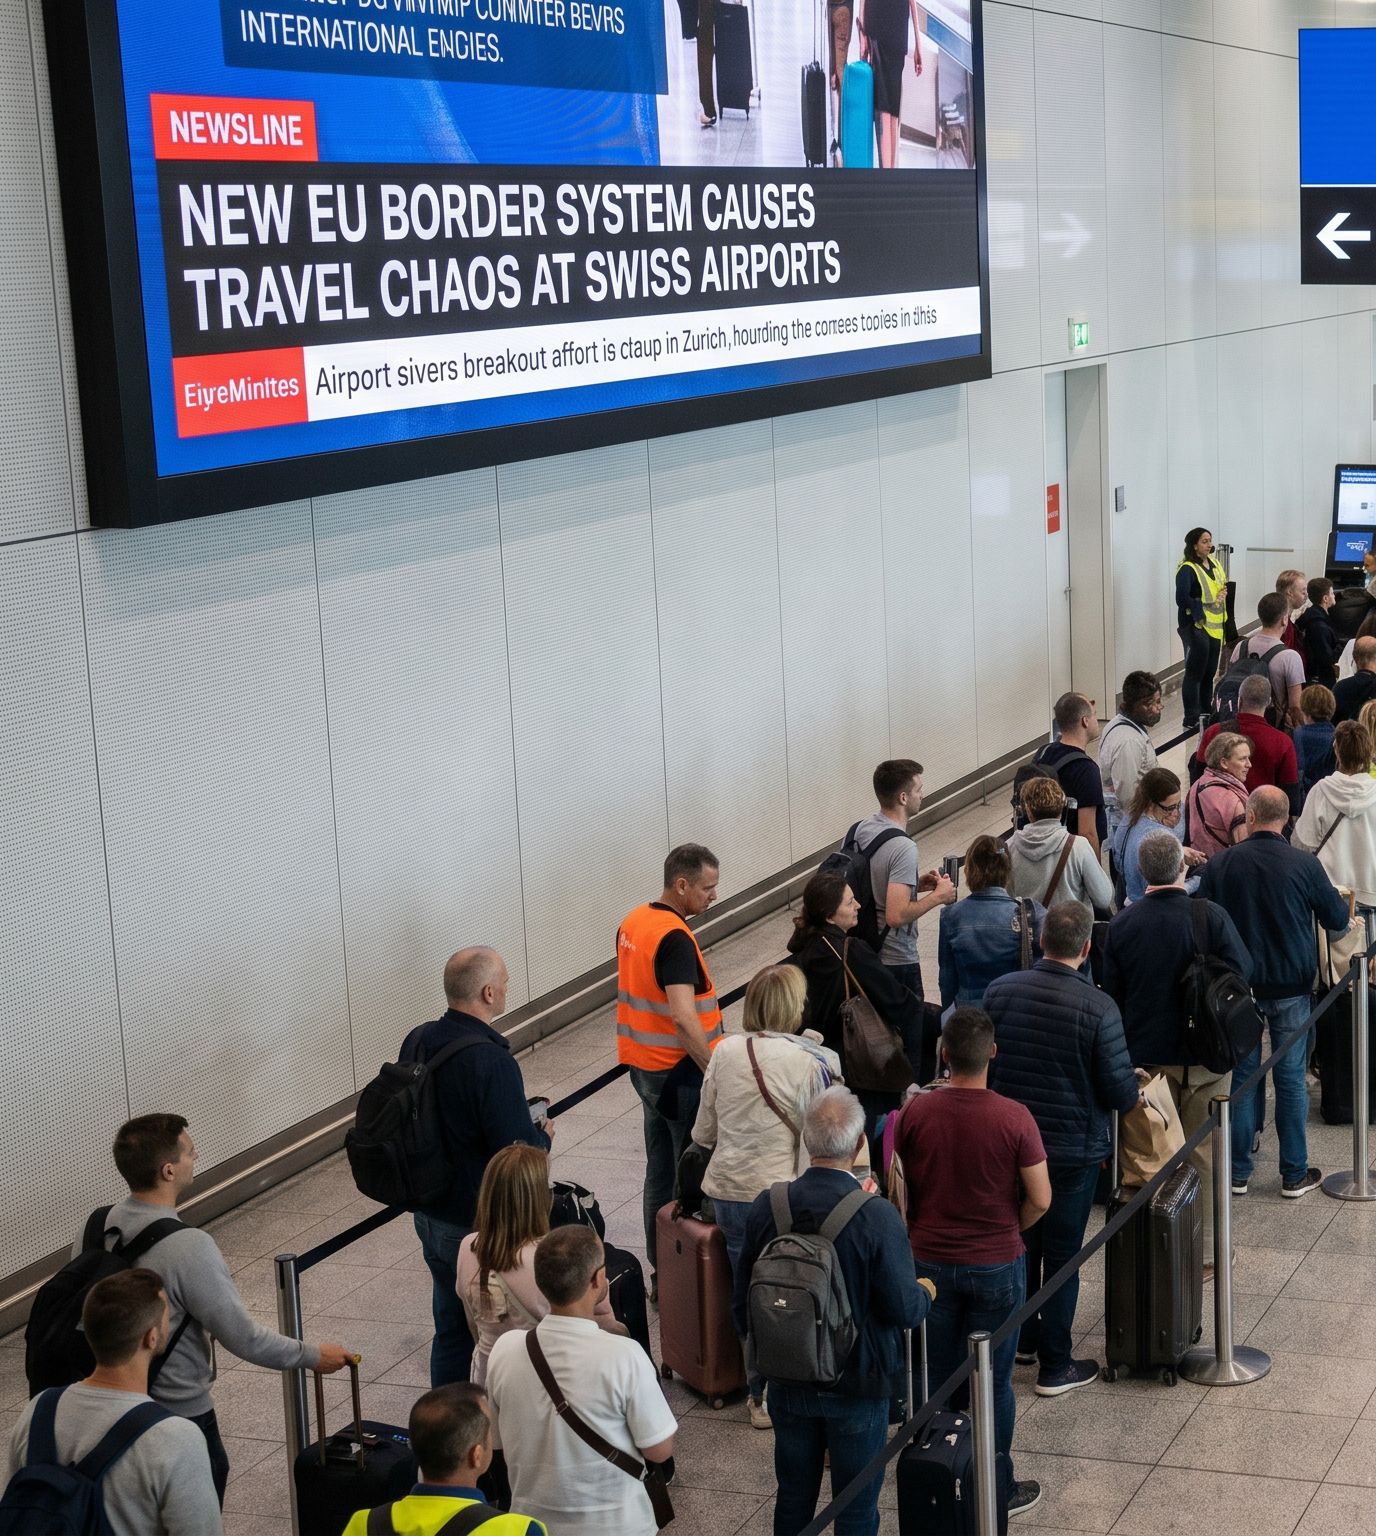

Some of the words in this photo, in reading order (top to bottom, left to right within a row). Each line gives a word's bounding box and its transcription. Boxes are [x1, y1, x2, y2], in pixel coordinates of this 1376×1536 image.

[240, 9, 424, 57] INTERNATIONAL
[571, 2, 625, 35] BEVRS
[170, 110, 304, 146] NEWSLINE
[178, 184, 294, 247] NEW
[307, 184, 367, 243] EU
[380, 183, 548, 241] BORDER
[556, 183, 693, 236] SYSTEM
[701, 182, 816, 232] CAUSES
[182, 263, 370, 331] TRAVEL
[380, 254, 522, 318] CHAOS
[531, 252, 576, 306] AT
[585, 246, 692, 302] SWISS
[700, 239, 841, 293] AIRPORTS
[315, 361, 392, 400] Airport
[397, 357, 459, 387] sivers
[463, 346, 548, 379] breakout
[552, 341, 599, 368] affort
[603, 337, 616, 362] is
[620, 336, 663, 362] ctaup
[666, 331, 679, 354] in
[682, 325, 732, 353] Zurich,
[791, 318, 812, 339] the
[900, 307, 911, 328] in
